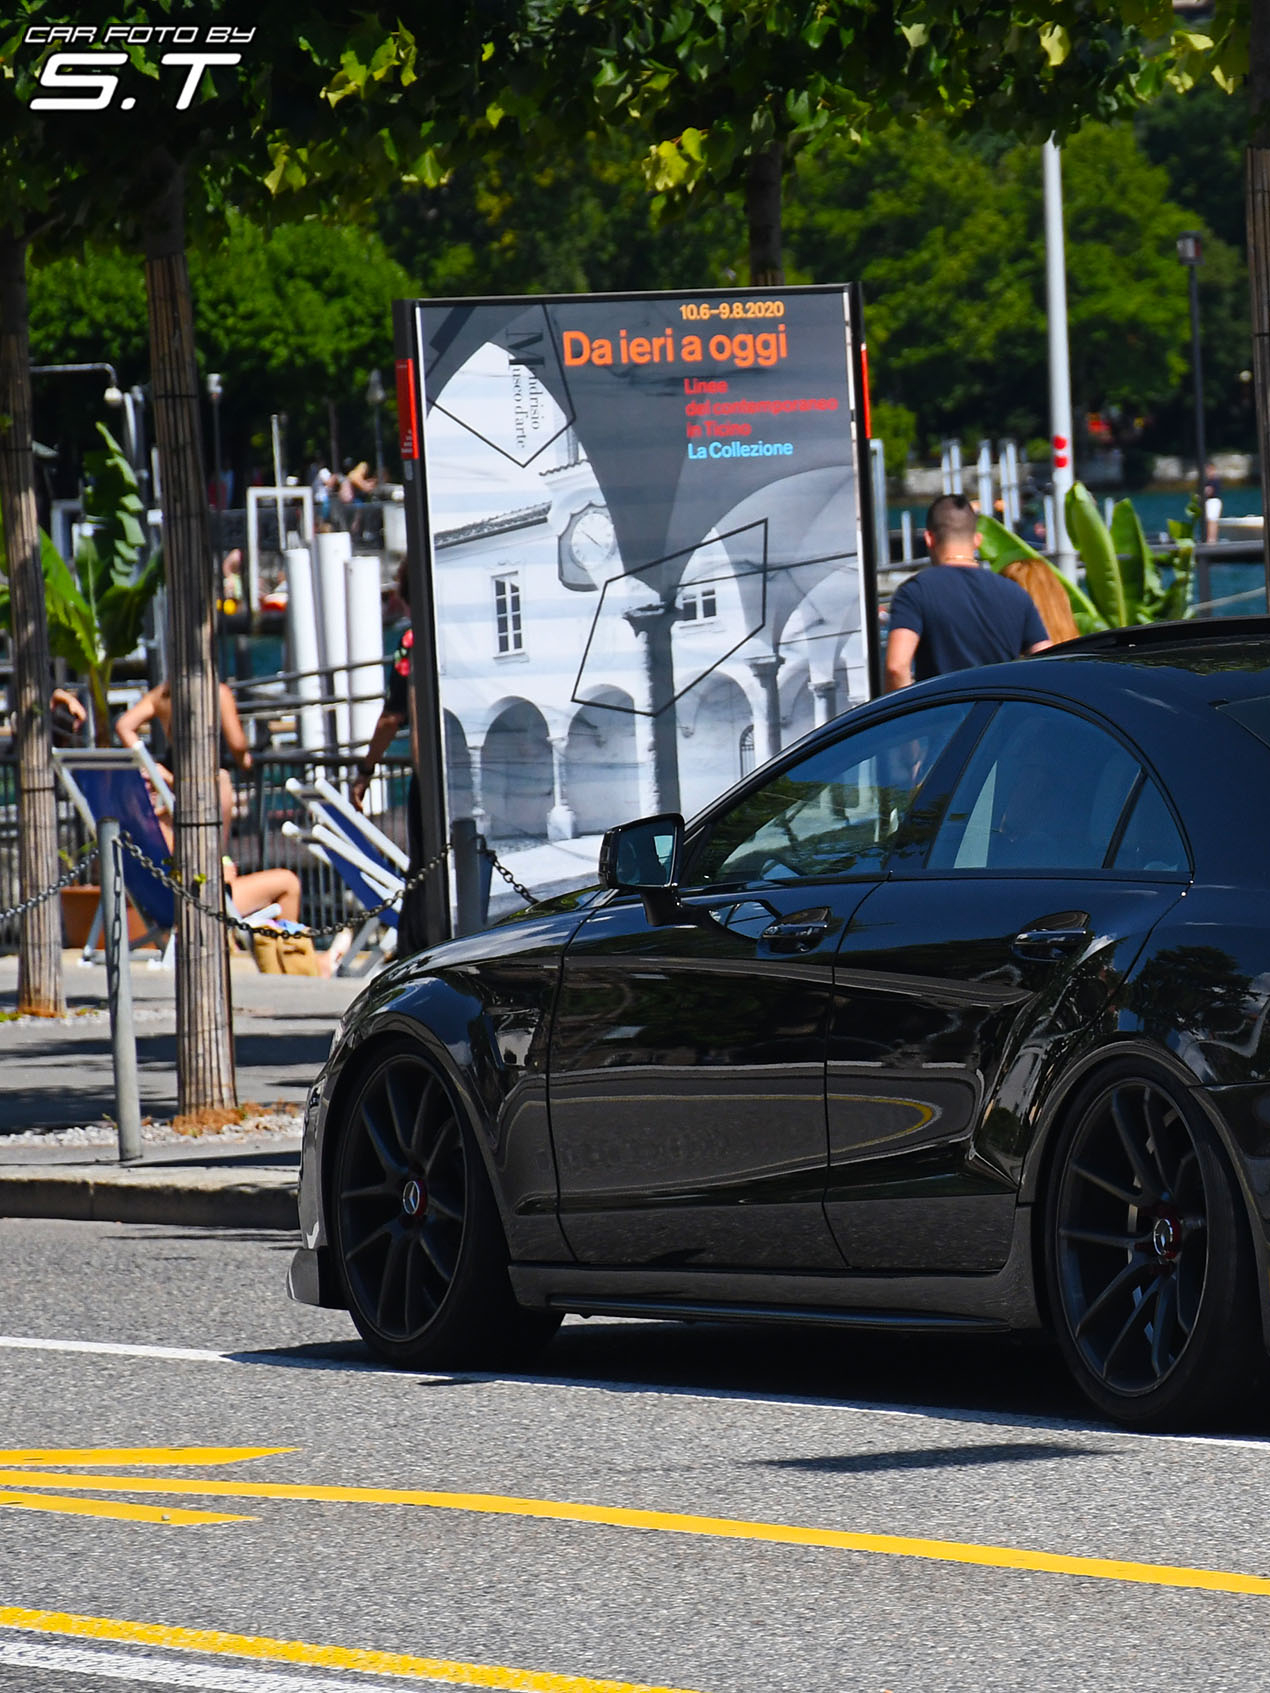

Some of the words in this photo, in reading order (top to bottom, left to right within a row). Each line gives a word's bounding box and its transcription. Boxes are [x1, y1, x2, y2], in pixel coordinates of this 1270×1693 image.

[562, 330, 612, 366] Da
[620, 328, 673, 364] ieri
[681, 335, 703, 362] a
[709, 323, 787, 368] oggi
[683, 378, 729, 395] Linee
[685, 400, 711, 417] del
[712, 397, 839, 416] contemporaneo
[686, 423, 702, 438] in
[704, 420, 752, 438] Ticino
[687, 443, 707, 459] La
[709, 440, 794, 459] Collezione
